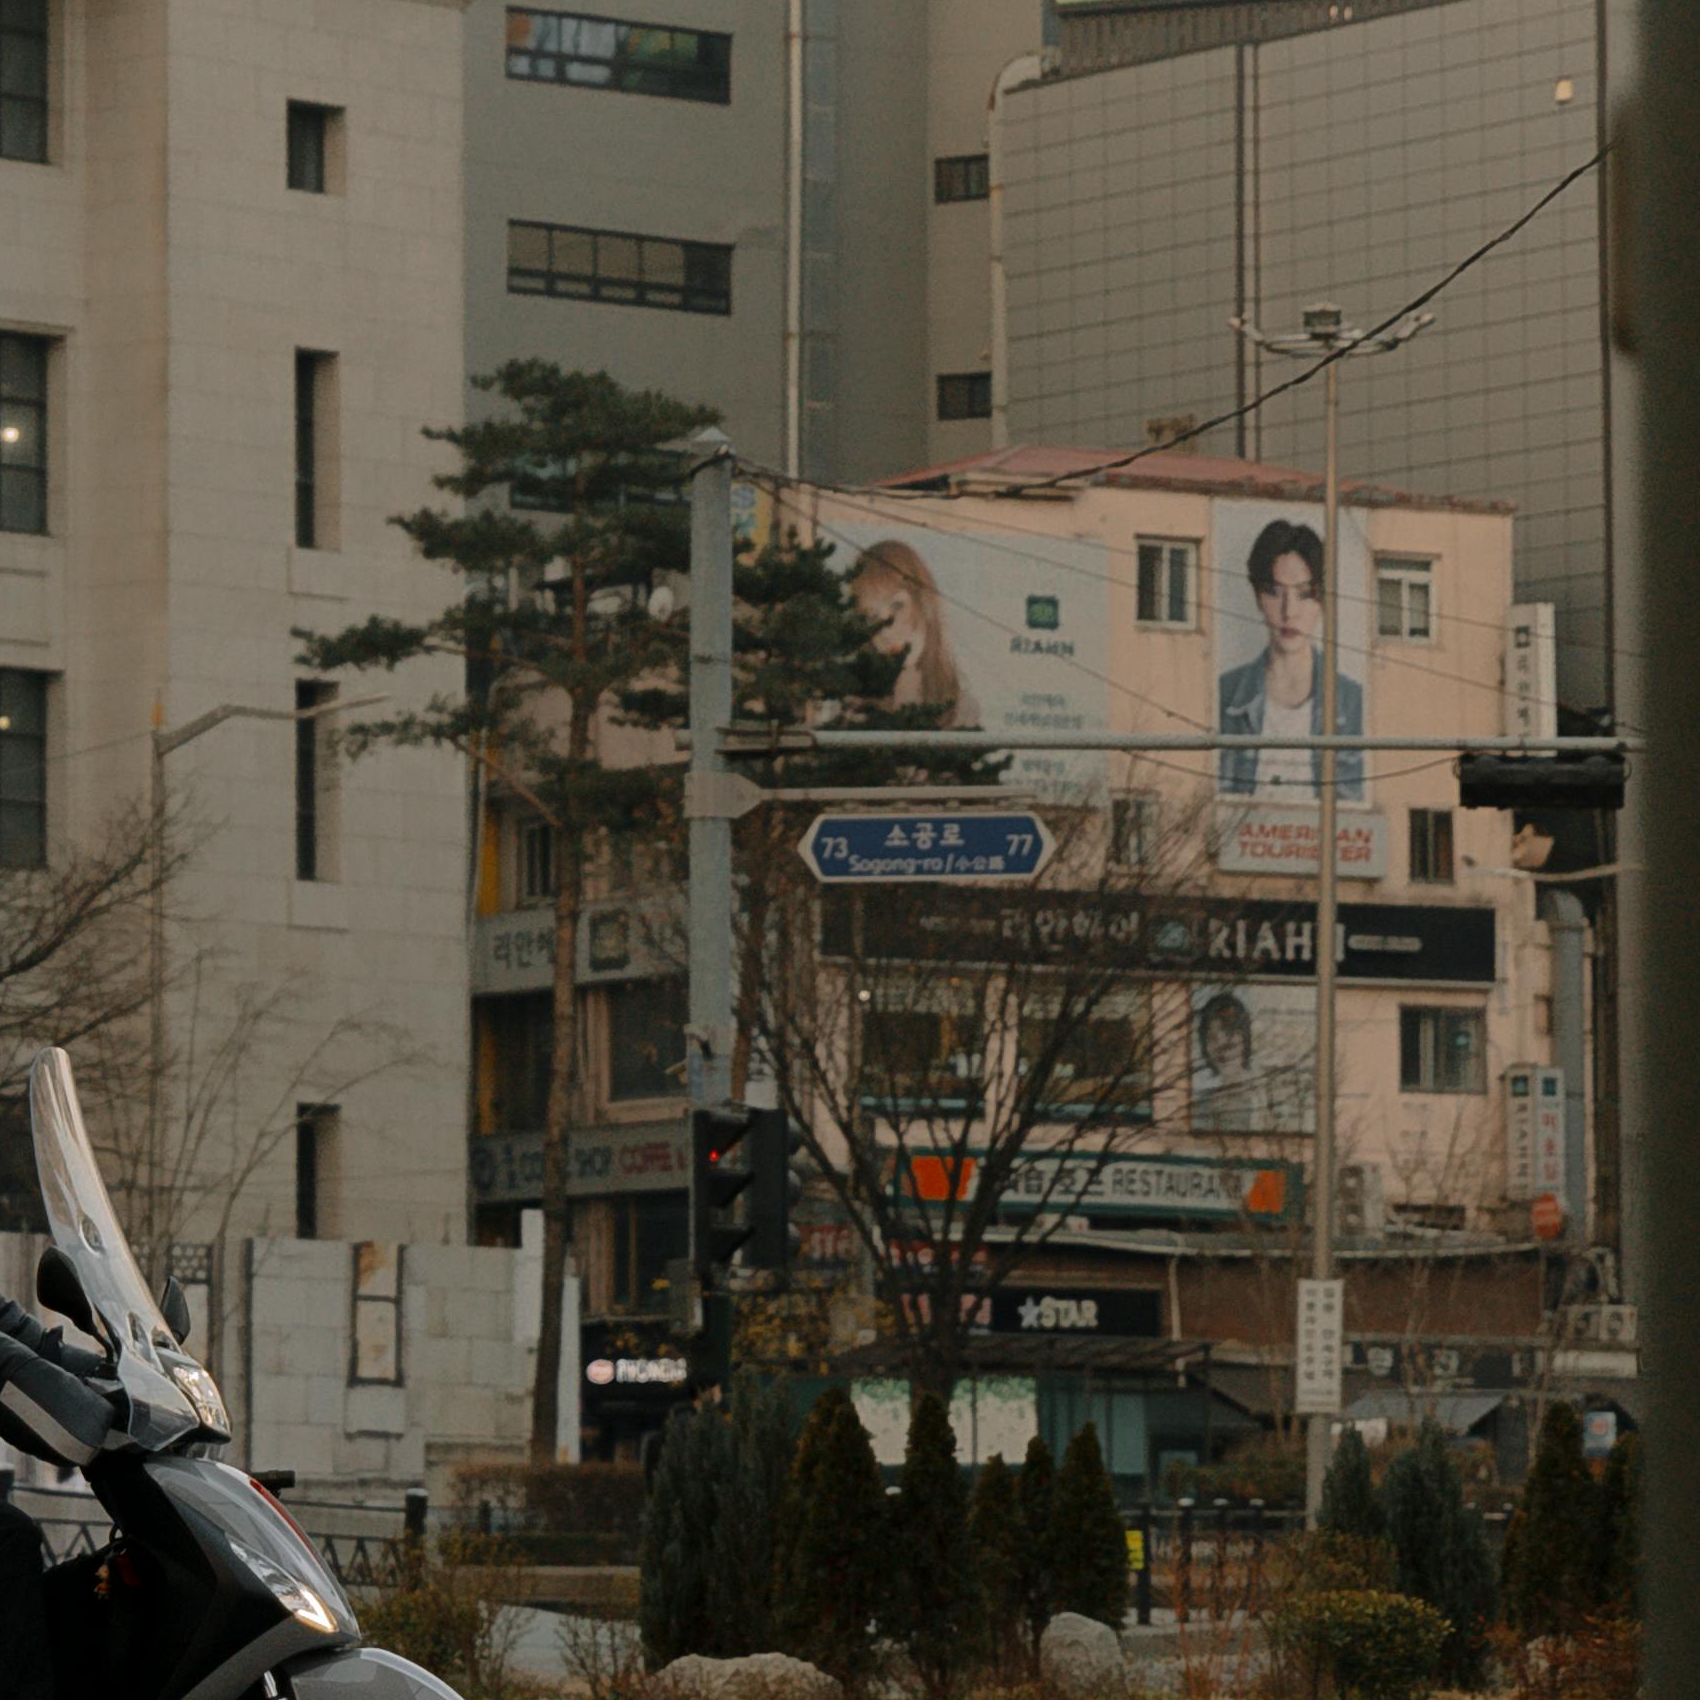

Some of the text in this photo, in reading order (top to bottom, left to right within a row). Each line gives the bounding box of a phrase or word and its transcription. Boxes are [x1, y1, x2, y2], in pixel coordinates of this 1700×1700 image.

[884, 822, 965, 850] 소공로
[1239, 823, 1373, 844] AMERIAN
[820, 837, 850, 860] 73
[1006, 834, 1034, 857] 77
[1239, 841, 1372, 863] TOURISER
[1039, 1296, 1098, 1329] STAR
